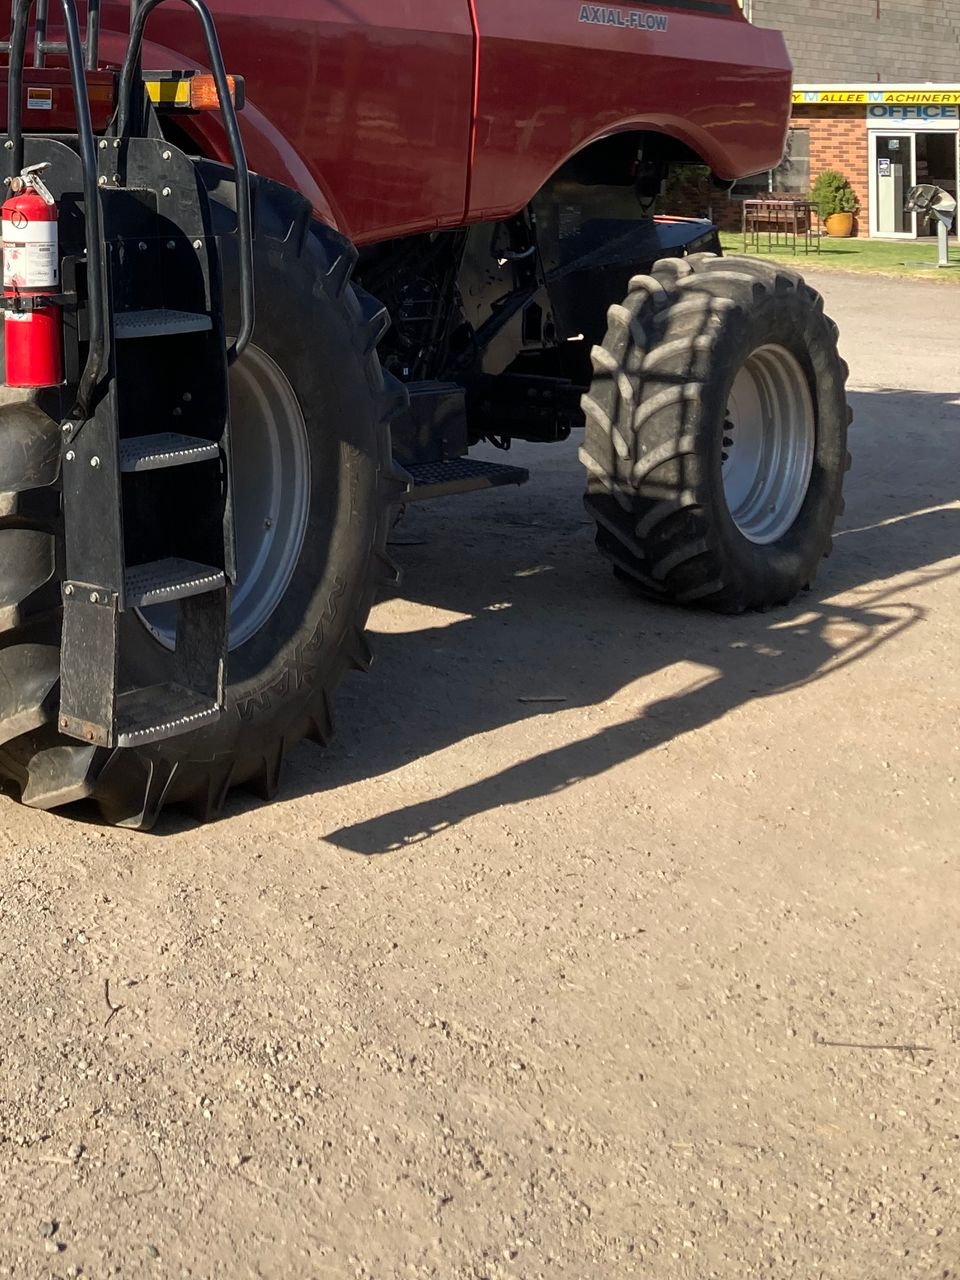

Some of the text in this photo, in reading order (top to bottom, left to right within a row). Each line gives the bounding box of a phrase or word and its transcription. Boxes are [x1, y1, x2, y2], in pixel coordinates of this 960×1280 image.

[578, 4, 669, 33] AXIAL-FLOW
[803, 91, 865, 102] MALLEE
[868, 91, 960, 102] MACHINERY
[869, 105, 957, 118] OFFICE
